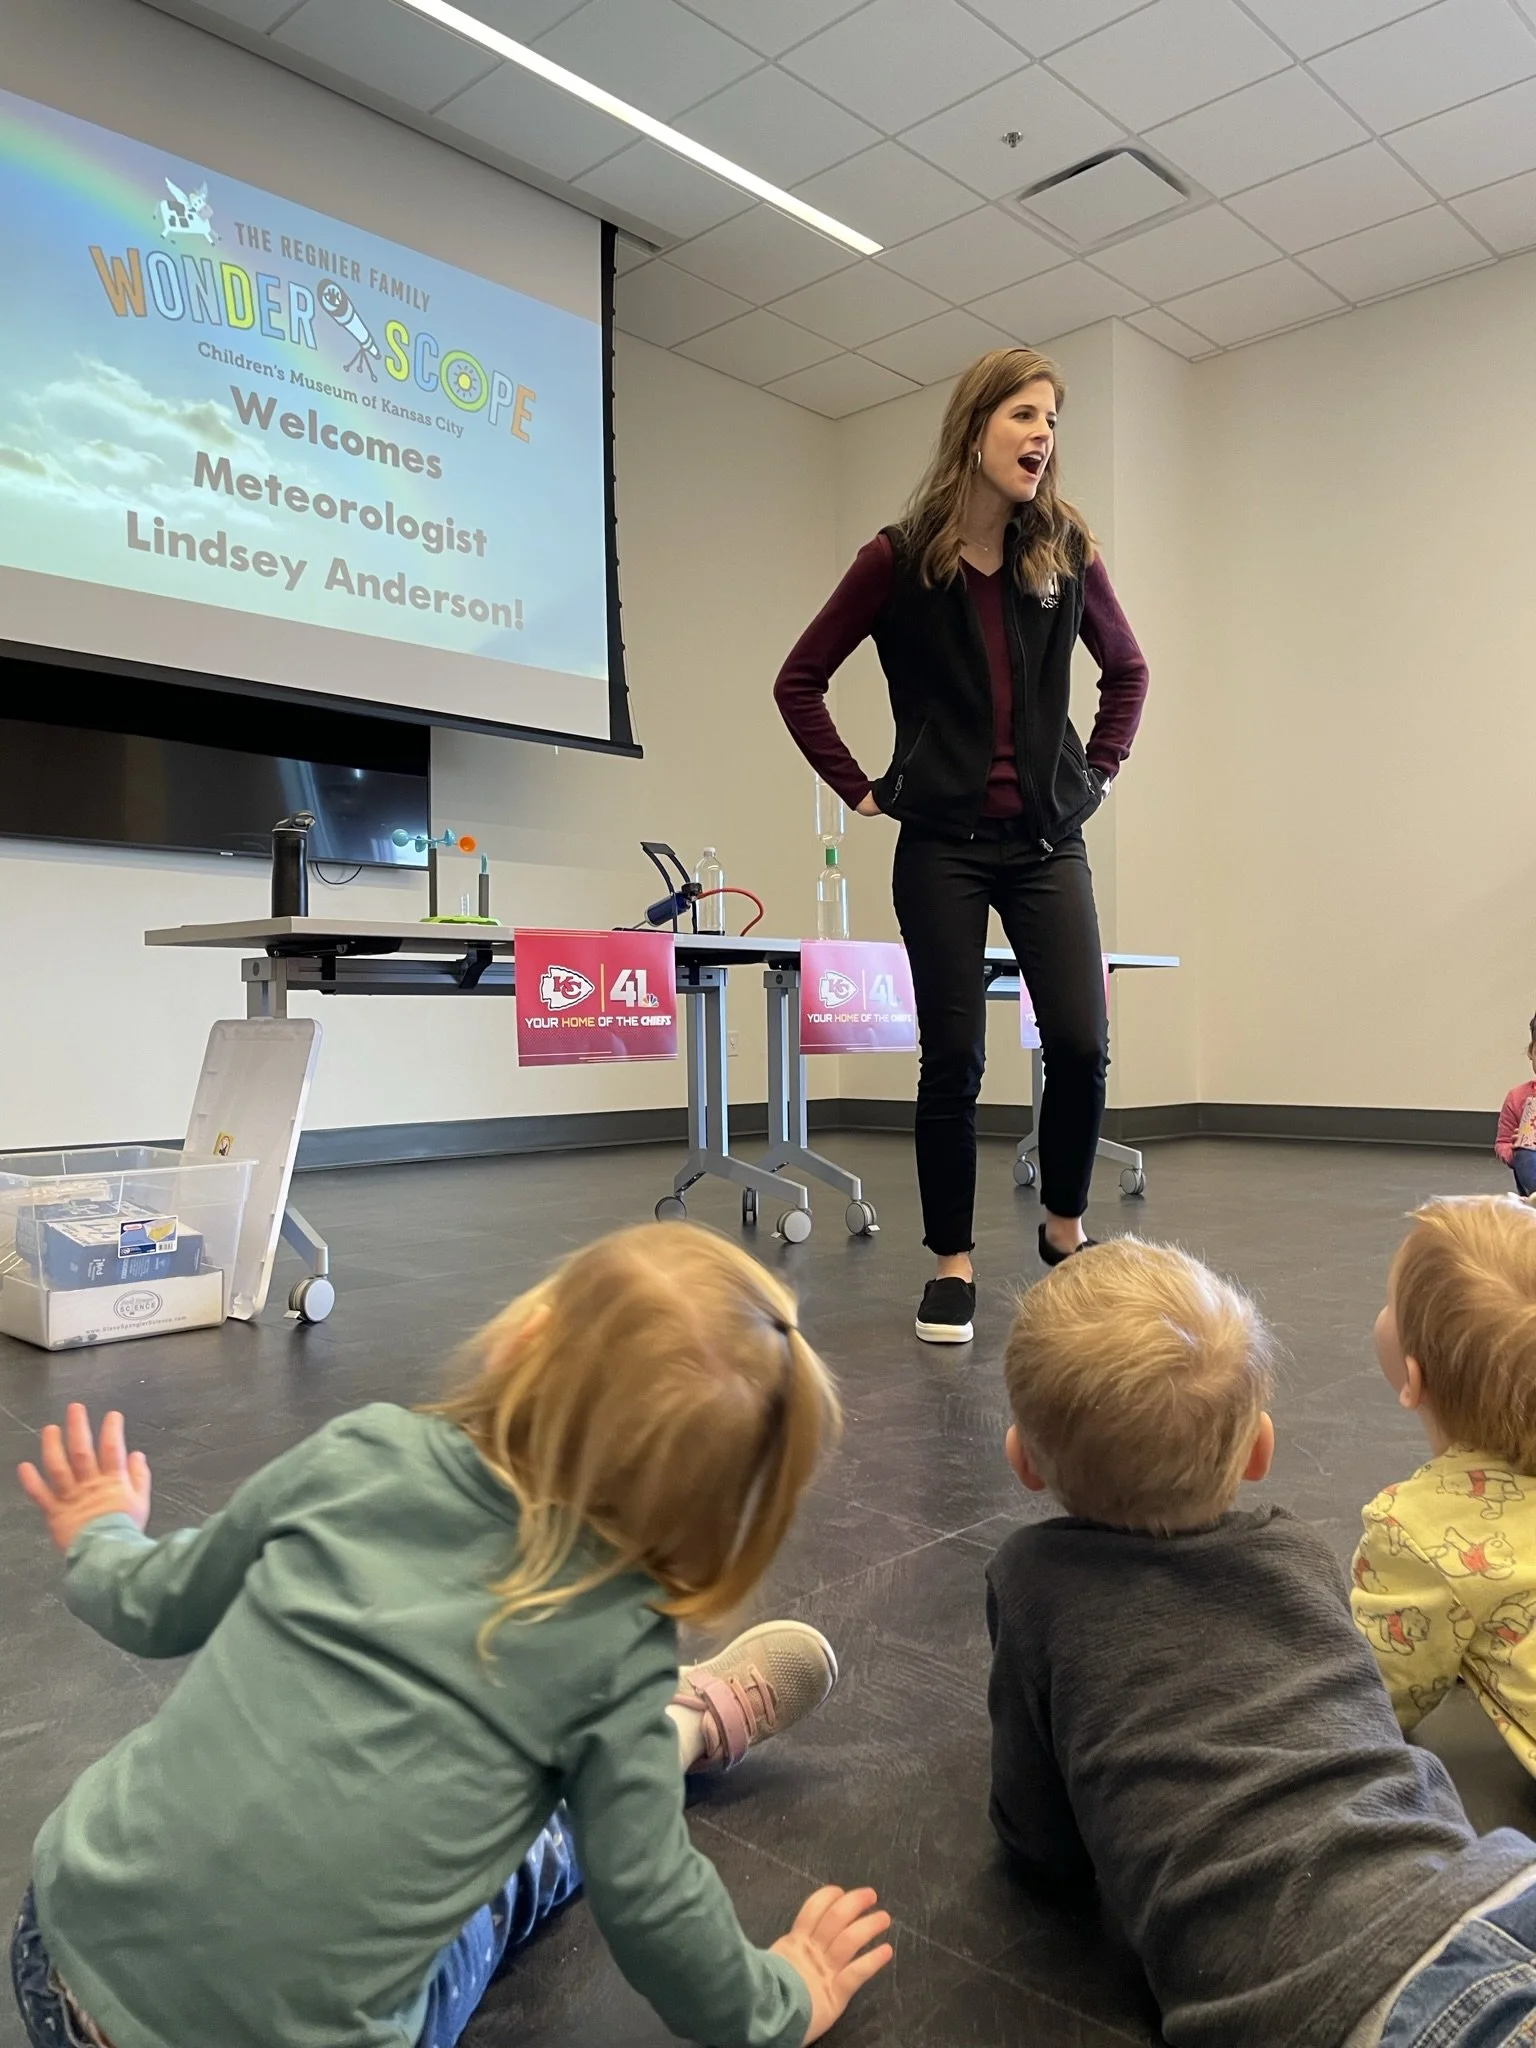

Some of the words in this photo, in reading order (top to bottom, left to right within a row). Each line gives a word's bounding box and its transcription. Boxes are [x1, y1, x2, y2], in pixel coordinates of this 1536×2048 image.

[234, 222, 273, 253] THE
[281, 235, 361, 283] REGNIER
[369, 268, 431, 312] FAMILY
[88, 245, 318, 350] WONDER
[384, 319, 537, 443] SCOPE
[198, 341, 285, 381] Children's
[290, 369, 359, 404] Museum
[361, 392, 377, 409] of
[381, 396, 432, 426] Kansas
[435, 415, 464, 439] City
[230, 385, 443, 480] Welcomes
[193, 450, 488, 558] Meteorologist
[126, 510, 308, 591] Lindsey
[324, 557, 524, 631] Anderson!
[525, 1017, 559, 1028] YOUR
[561, 1016, 595, 1027] HOME
[598, 1016, 614, 1027] OF
[616, 1016, 639, 1026] THE
[640, 1015, 672, 1026] CHIEFS
[553, 976, 582, 999] KC
[610, 969, 647, 1008] 41
[807, 1013, 833, 1023] YOUR
[834, 1013, 860, 1023] HOME
[860, 1013, 874, 1023] OF
[874, 1013, 890, 1022] THE
